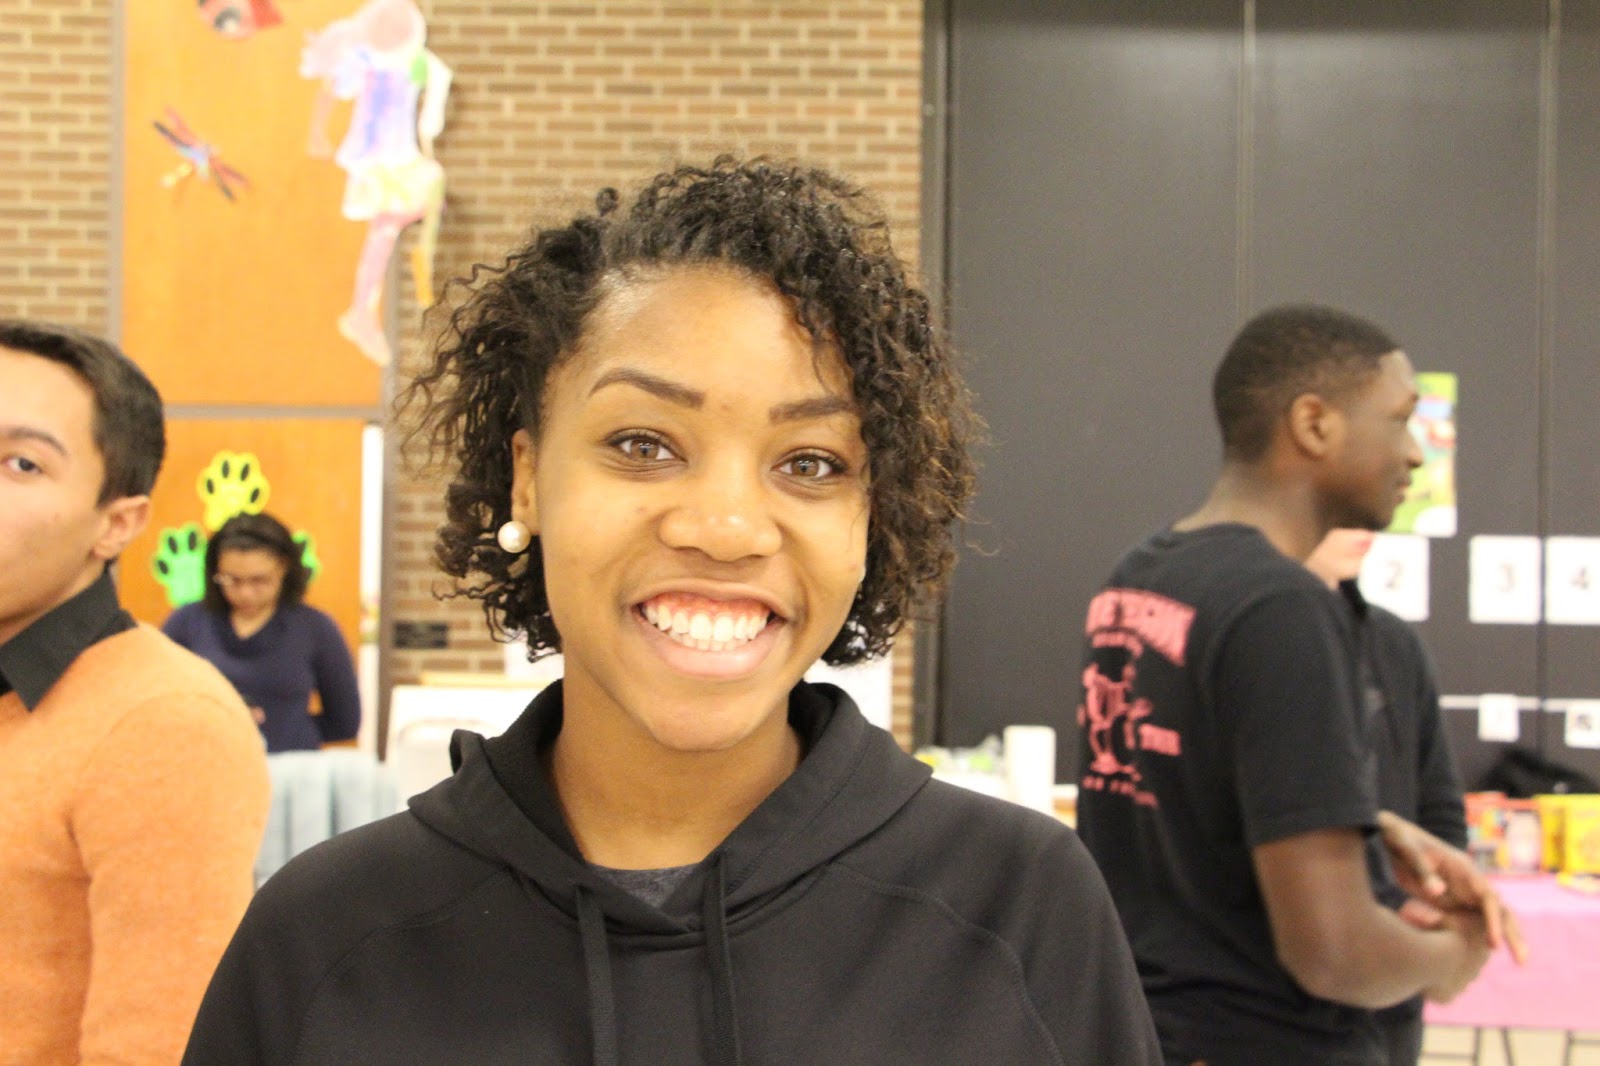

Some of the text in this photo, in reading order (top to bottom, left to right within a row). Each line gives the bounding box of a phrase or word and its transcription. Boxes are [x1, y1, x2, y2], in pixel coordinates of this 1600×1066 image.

[1383, 560, 1403, 591] 2
[1496, 562, 1516, 593] 3
[1568, 565, 1590, 591] 4
